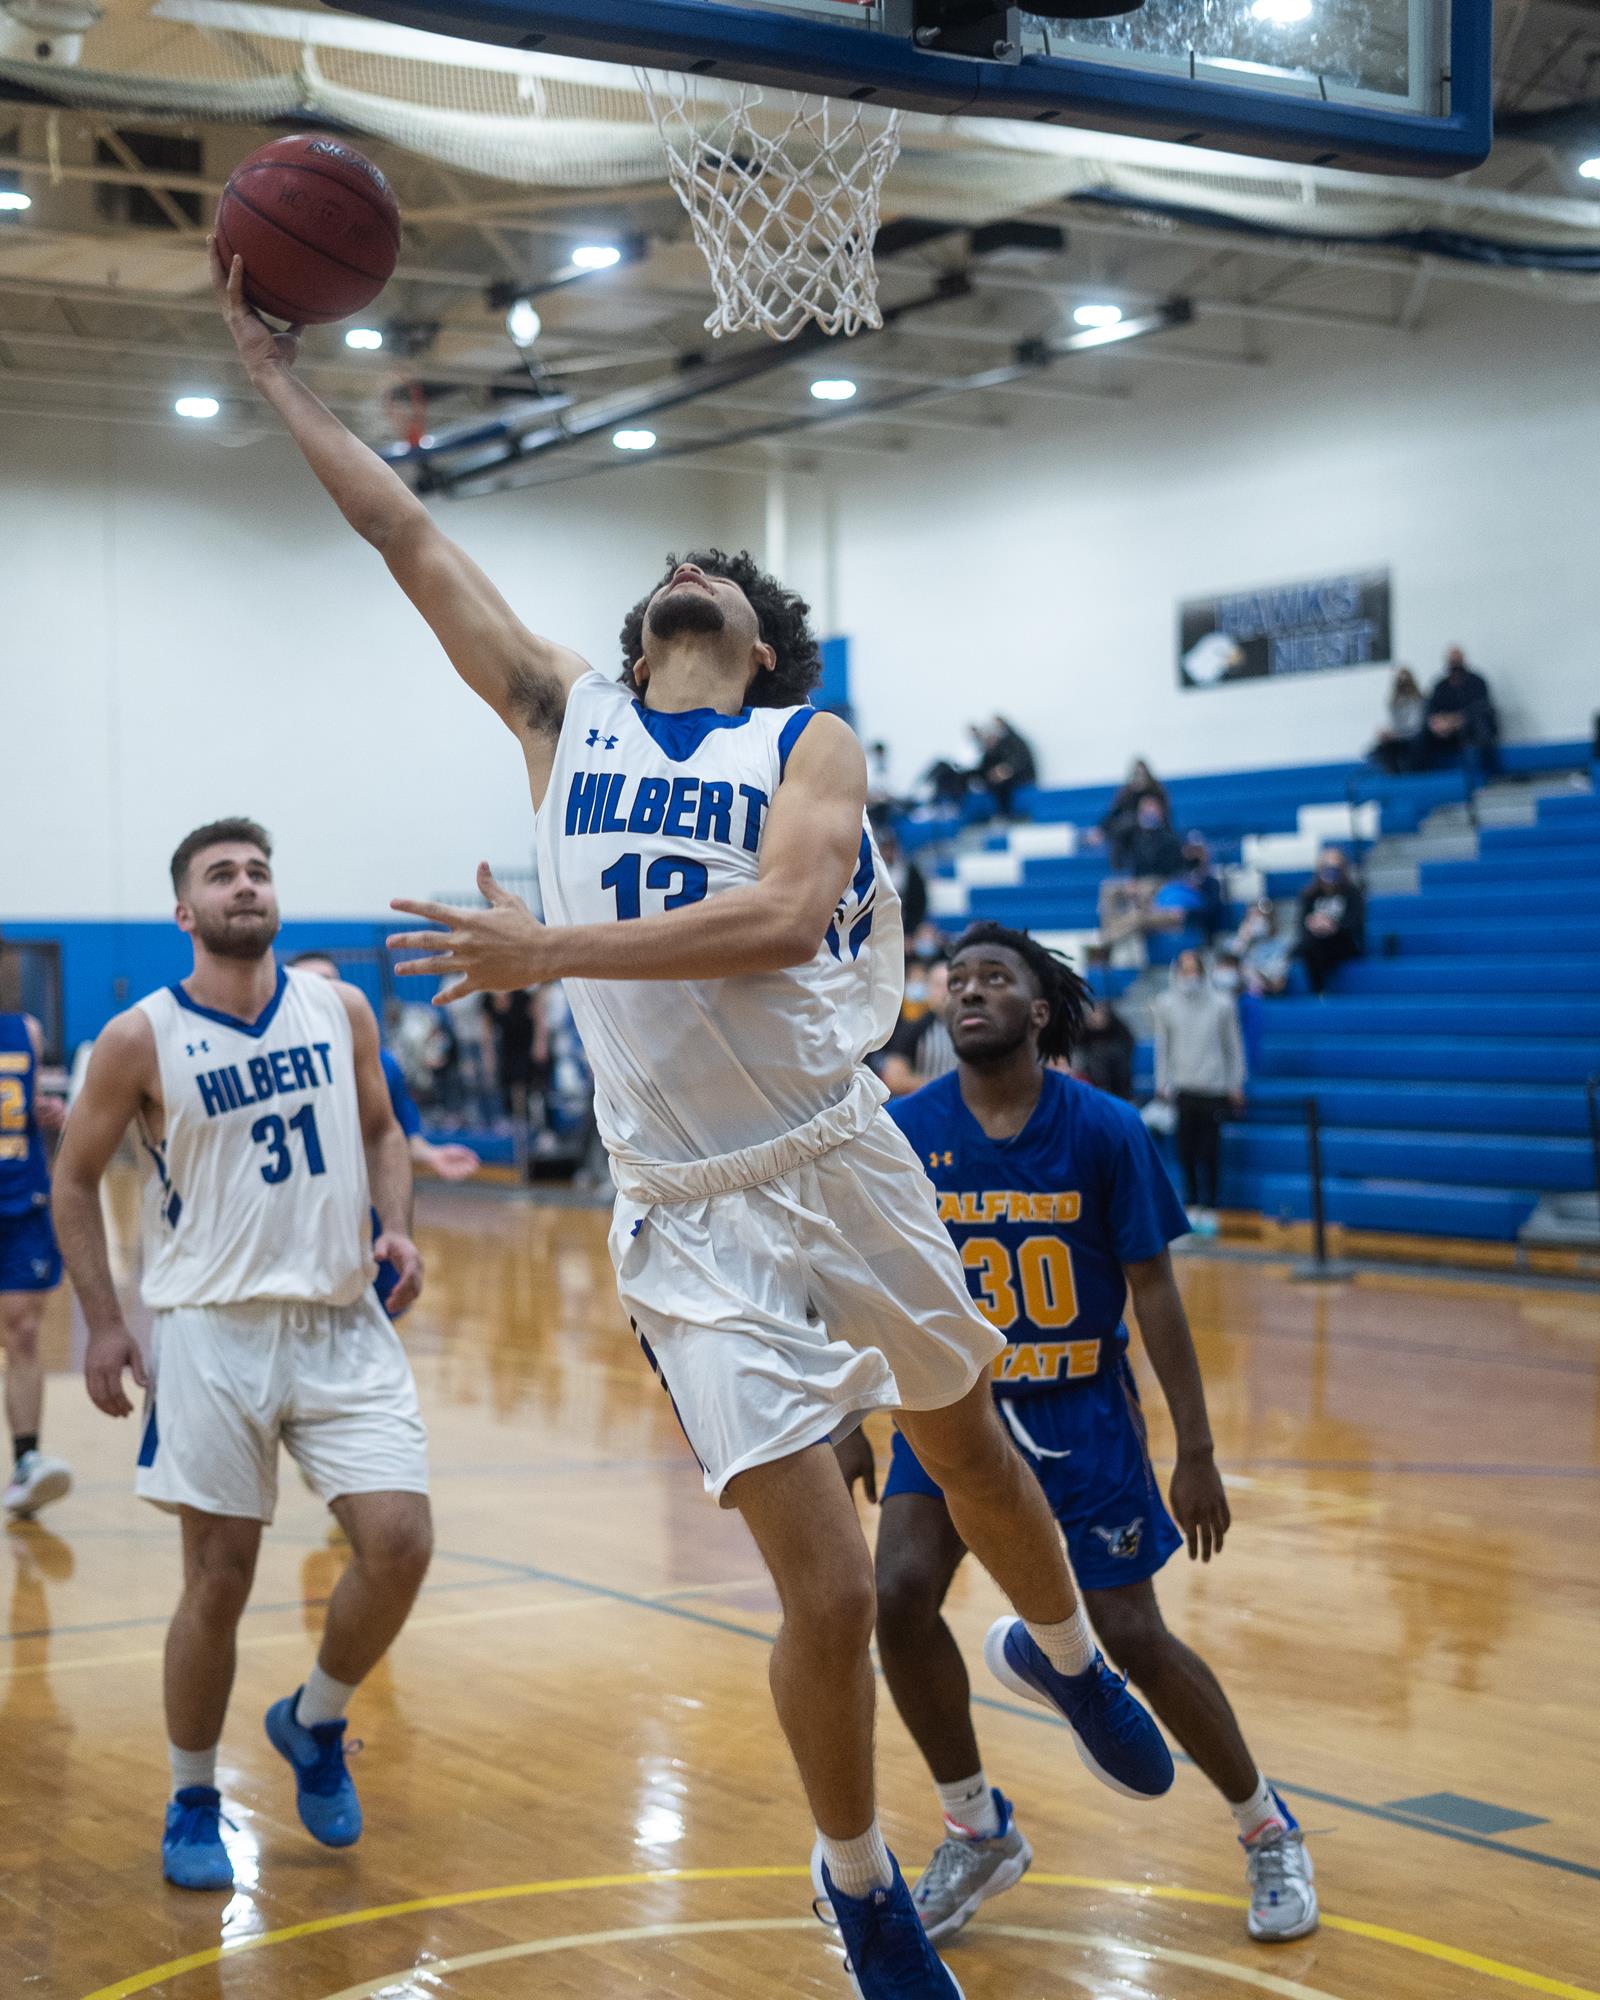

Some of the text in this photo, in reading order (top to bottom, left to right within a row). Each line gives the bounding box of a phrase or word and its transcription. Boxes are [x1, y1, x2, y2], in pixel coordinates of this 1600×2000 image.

[1215, 574, 1361, 636] HAWKS
[1269, 620, 1375, 675] NEST
[564, 771, 769, 853] HILBERT
[196, 1042, 333, 1118] HILBERT
[251, 1103, 326, 1186] 31
[936, 1190, 1082, 1224] ALFRED
[959, 1235, 1080, 1329] 30
[990, 1338, 1101, 1382] TATE
